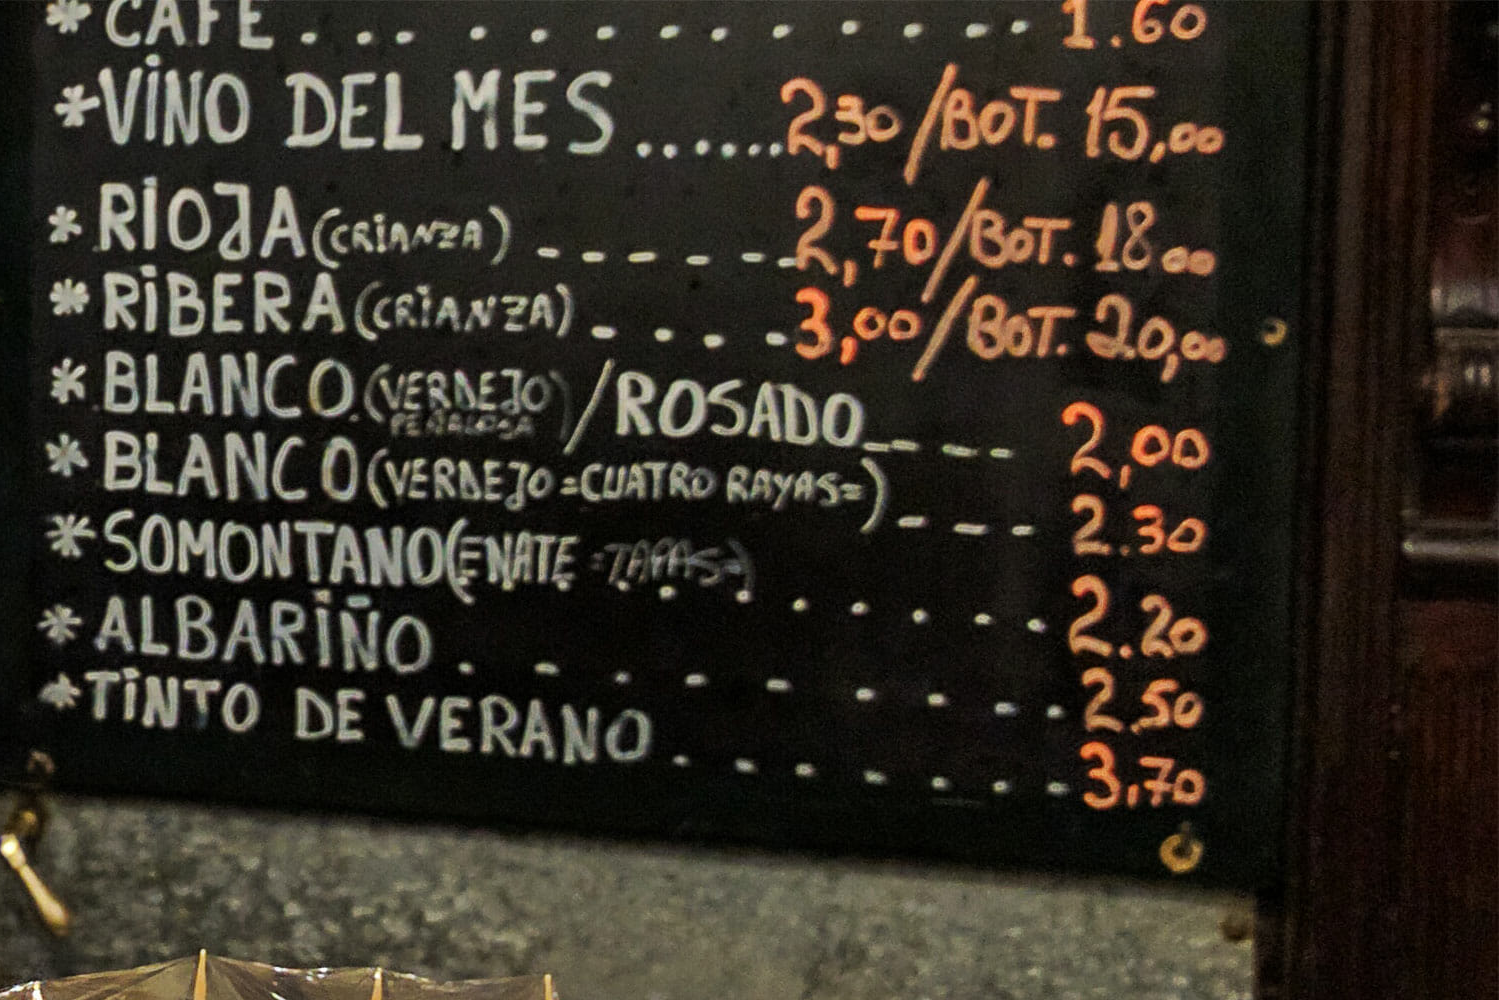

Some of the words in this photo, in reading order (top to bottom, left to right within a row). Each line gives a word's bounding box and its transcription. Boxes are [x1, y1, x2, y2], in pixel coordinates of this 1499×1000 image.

[285, 71, 423, 149] DEL
[451, 69, 614, 154] MES
[103, 351, 354, 418] BLANCO
[1062, 402, 1210, 488] 2,00
[103, 431, 358, 502] BLANCO
[103, 510, 443, 587] SOMONTANO
[94, 590, 432, 673] ALBARIÑO
[295, 687, 365, 742] DE
[386, 694, 652, 764] VERANO
